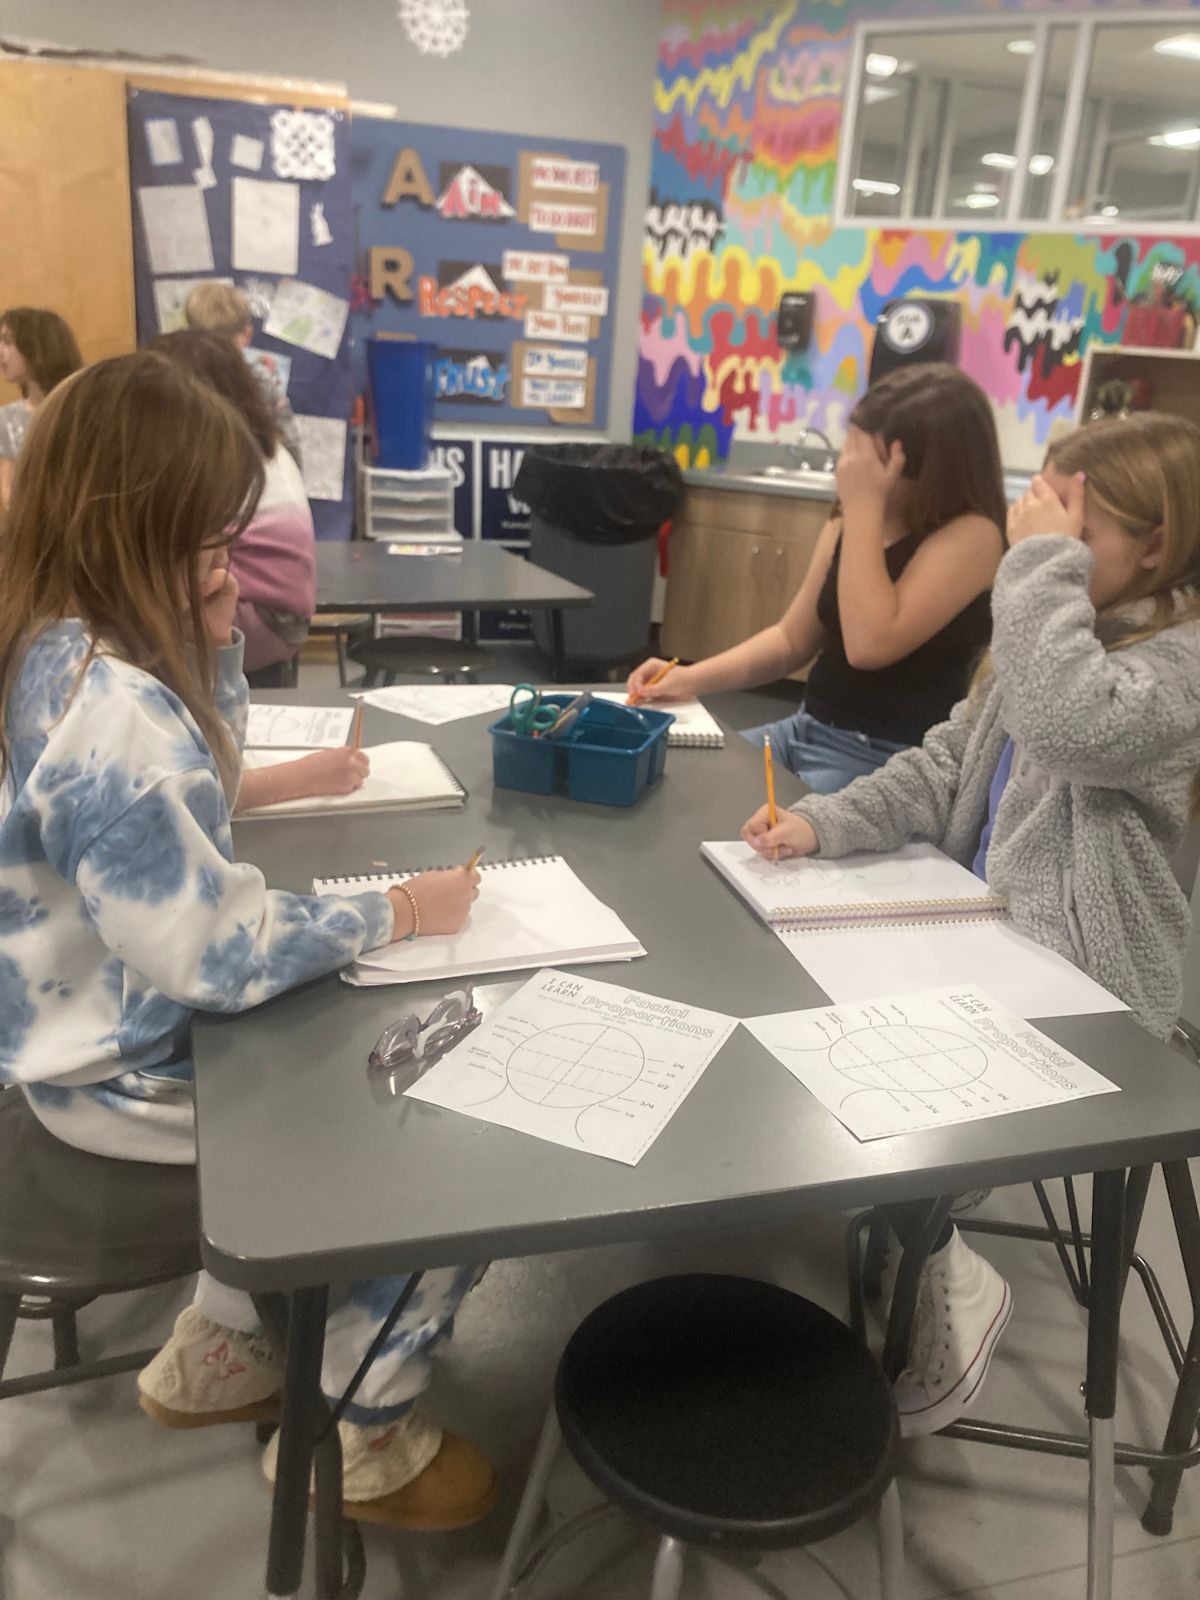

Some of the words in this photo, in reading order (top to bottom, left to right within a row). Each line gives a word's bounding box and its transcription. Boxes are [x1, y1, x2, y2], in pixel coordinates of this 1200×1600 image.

[382, 147, 437, 204] A
[369, 246, 414, 301] R
[541, 984, 579, 998] LEARN
[560, 979, 584, 991] CAN
[582, 995, 715, 1038] Proportions
[623, 994, 690, 1019] Facial
[973, 1018, 1079, 1091] Proportions
[1015, 1031, 1076, 1068] Facial
